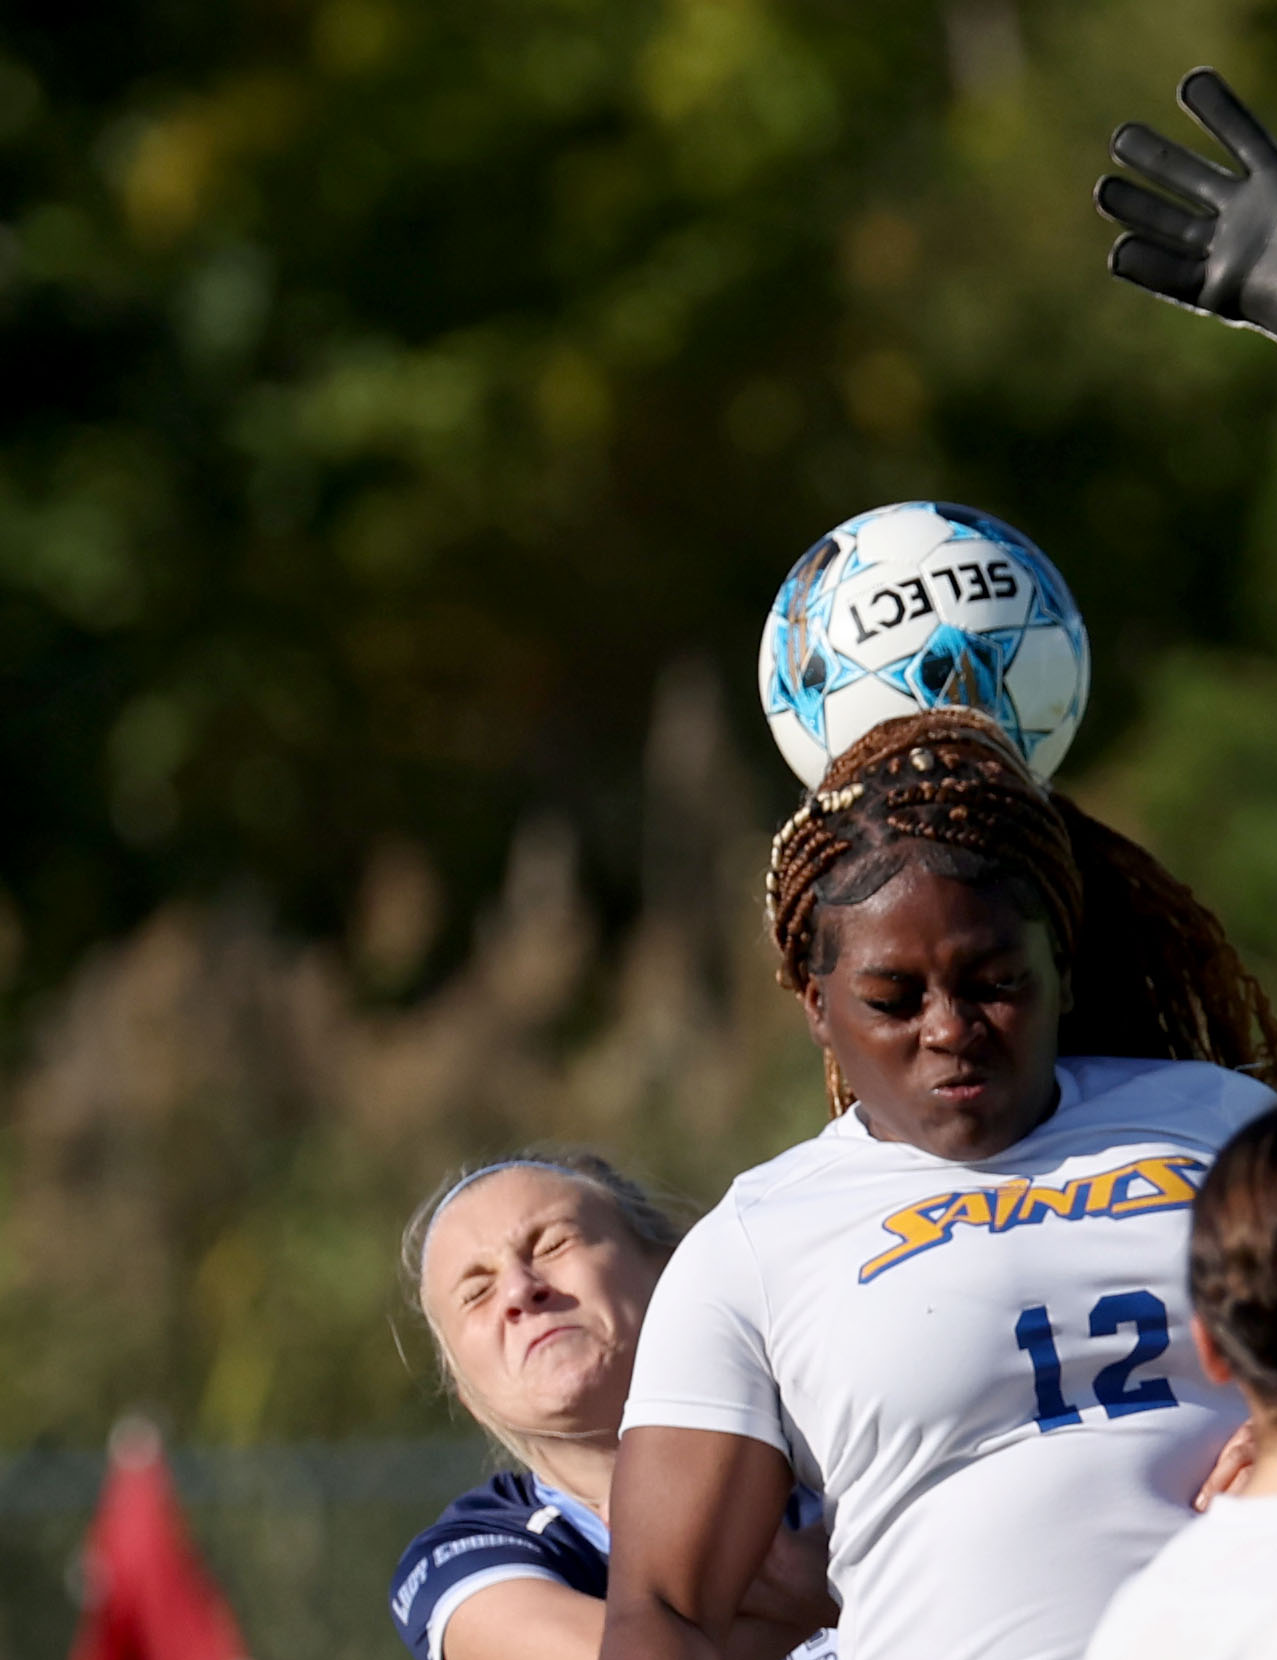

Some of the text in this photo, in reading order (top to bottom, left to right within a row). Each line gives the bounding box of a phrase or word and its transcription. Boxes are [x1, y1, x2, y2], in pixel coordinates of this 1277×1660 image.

[849, 561, 1018, 645] SELECT
[858, 1155, 1208, 1285] SAINTS
[1015, 1290, 1180, 1433] 12
